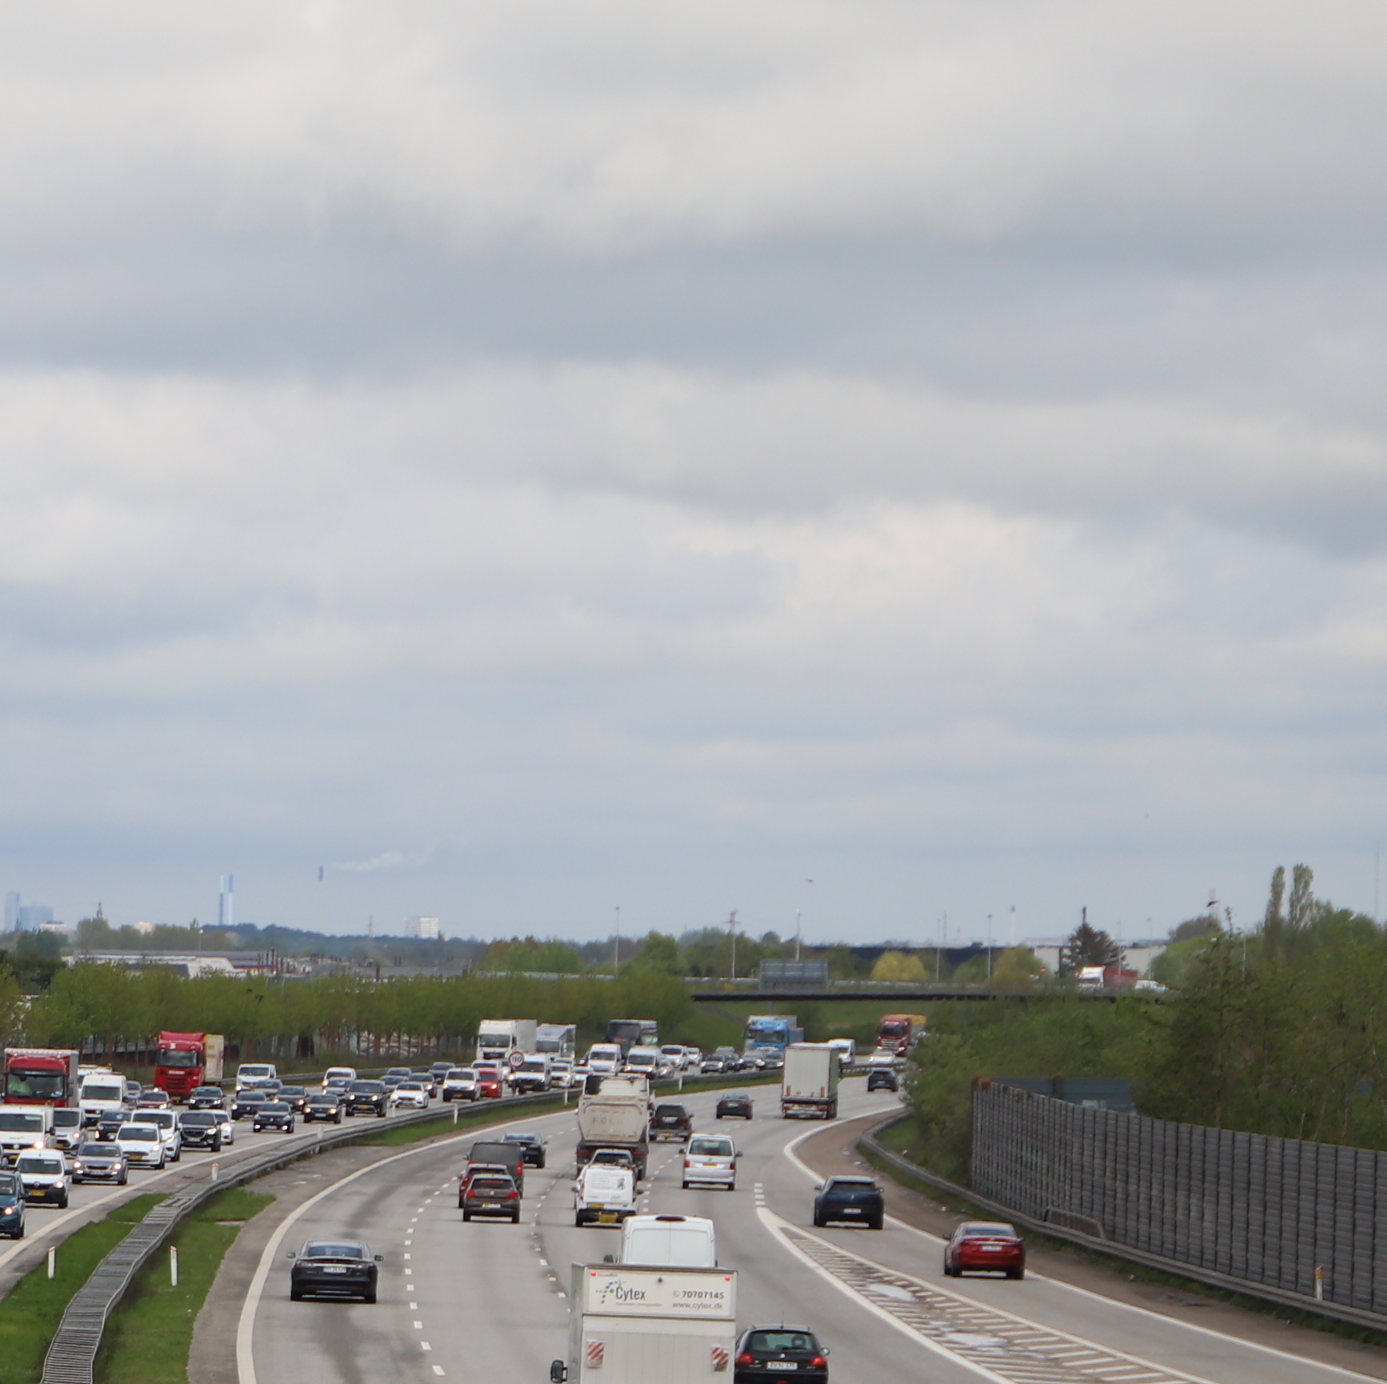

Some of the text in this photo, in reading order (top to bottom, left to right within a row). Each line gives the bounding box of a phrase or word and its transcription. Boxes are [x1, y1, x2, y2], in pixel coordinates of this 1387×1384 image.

[615, 1286, 646, 1301] Cytex
[682, 1290, 725, 1299] 70707145
[672, 1301, 724, 1310] www.cytex.dk
